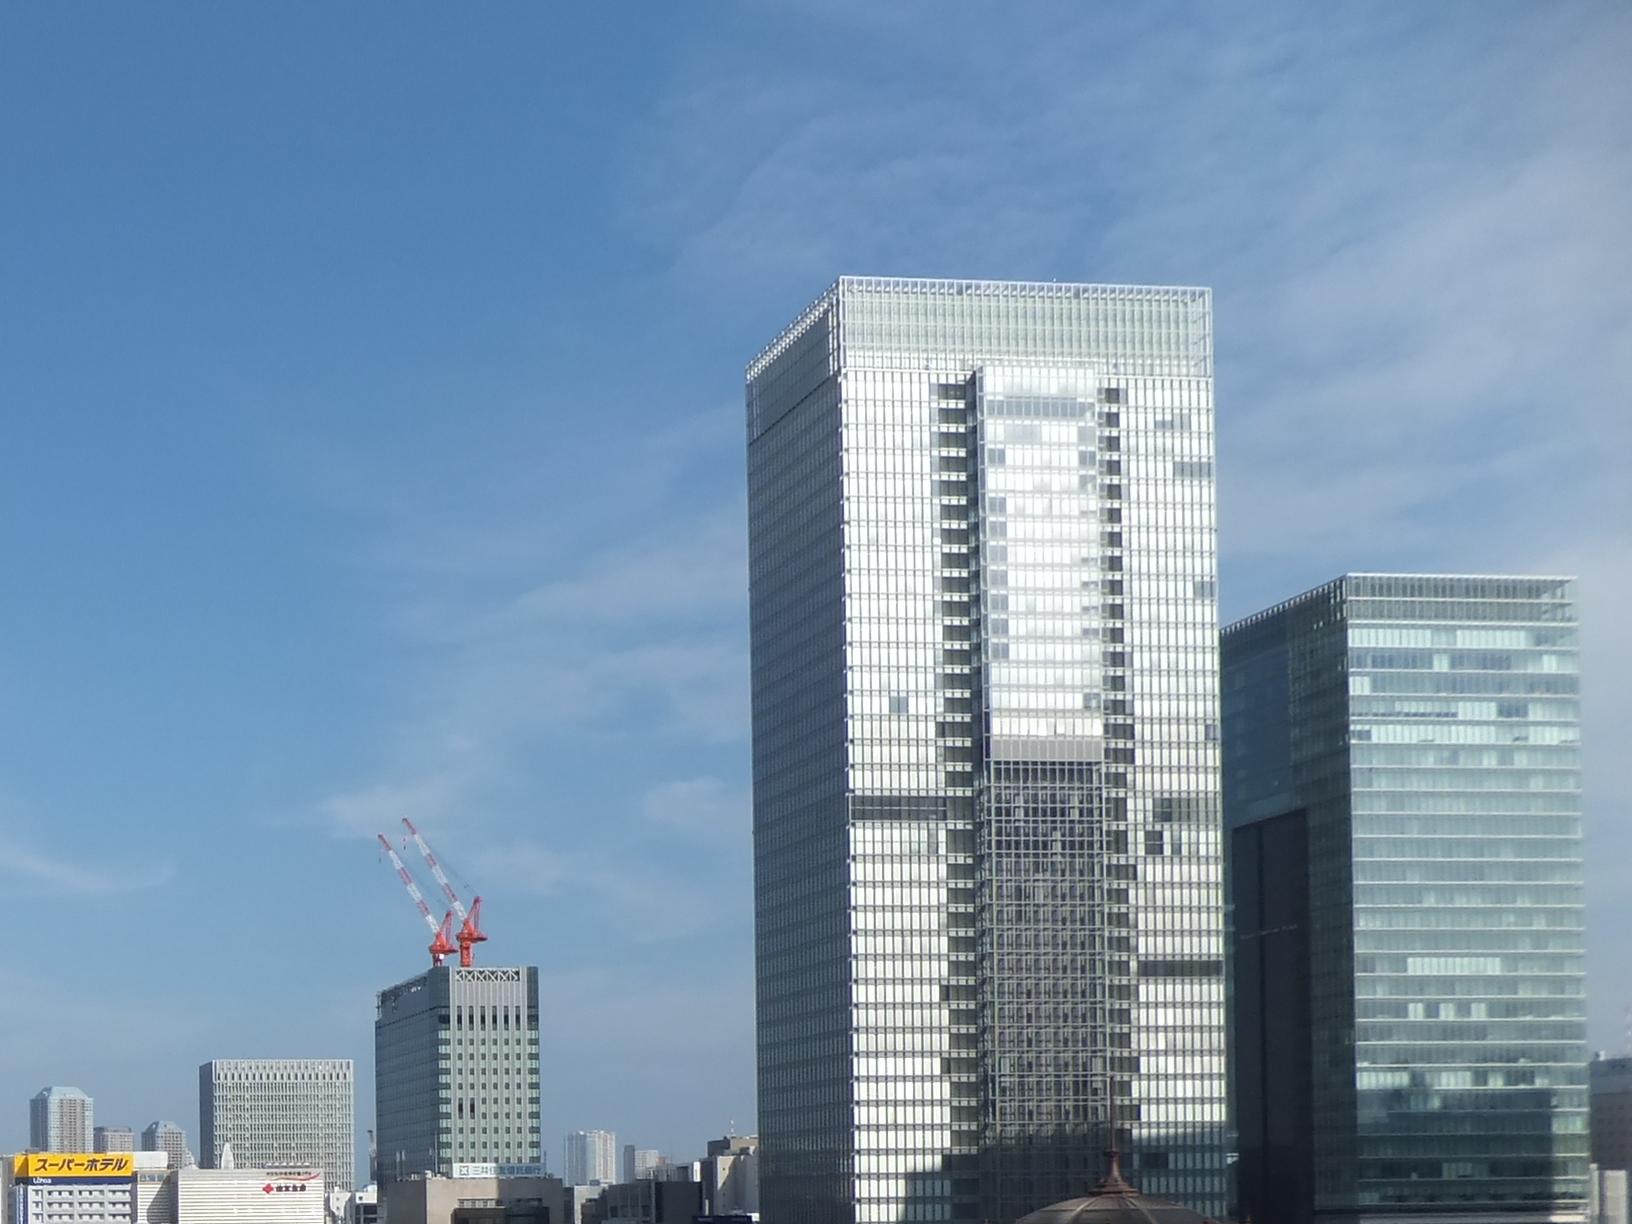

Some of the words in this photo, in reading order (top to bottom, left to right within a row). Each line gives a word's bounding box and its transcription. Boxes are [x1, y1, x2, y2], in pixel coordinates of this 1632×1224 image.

[35, 1158, 129, 1171] スーパーホテル
